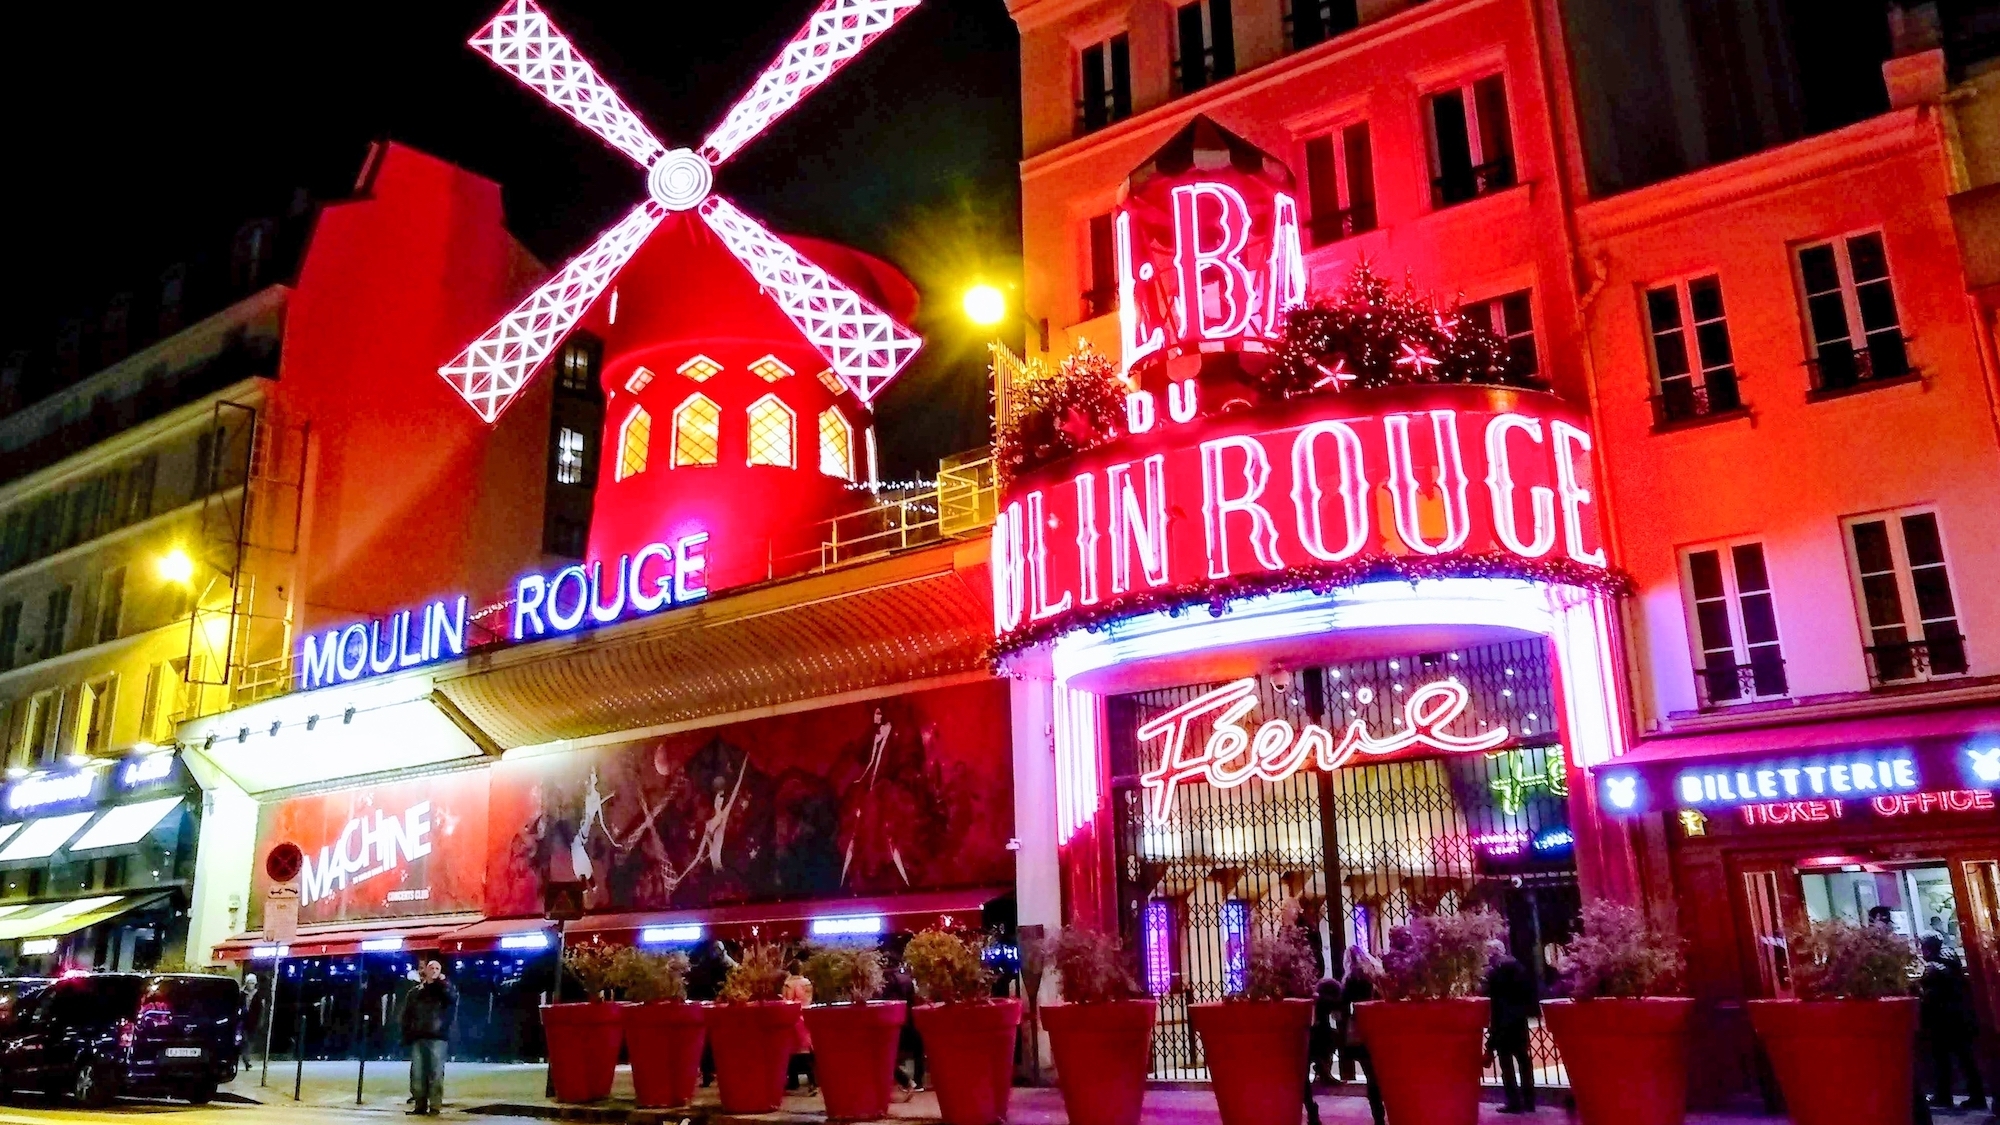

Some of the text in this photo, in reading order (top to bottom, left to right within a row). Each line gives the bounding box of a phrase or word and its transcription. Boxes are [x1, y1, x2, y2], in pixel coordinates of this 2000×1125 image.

[1126, 378, 1198, 434] DU
[1199, 409, 1607, 580] ROUGE
[302, 531, 711, 689] MOULIN ROUGE
[1137, 677, 1509, 826] Féerie
[1681, 758, 1917, 803] BILLETTERIE
[301, 800, 432, 907] MACHINE
[1741, 788, 1996, 826] TICKET OFFICE
